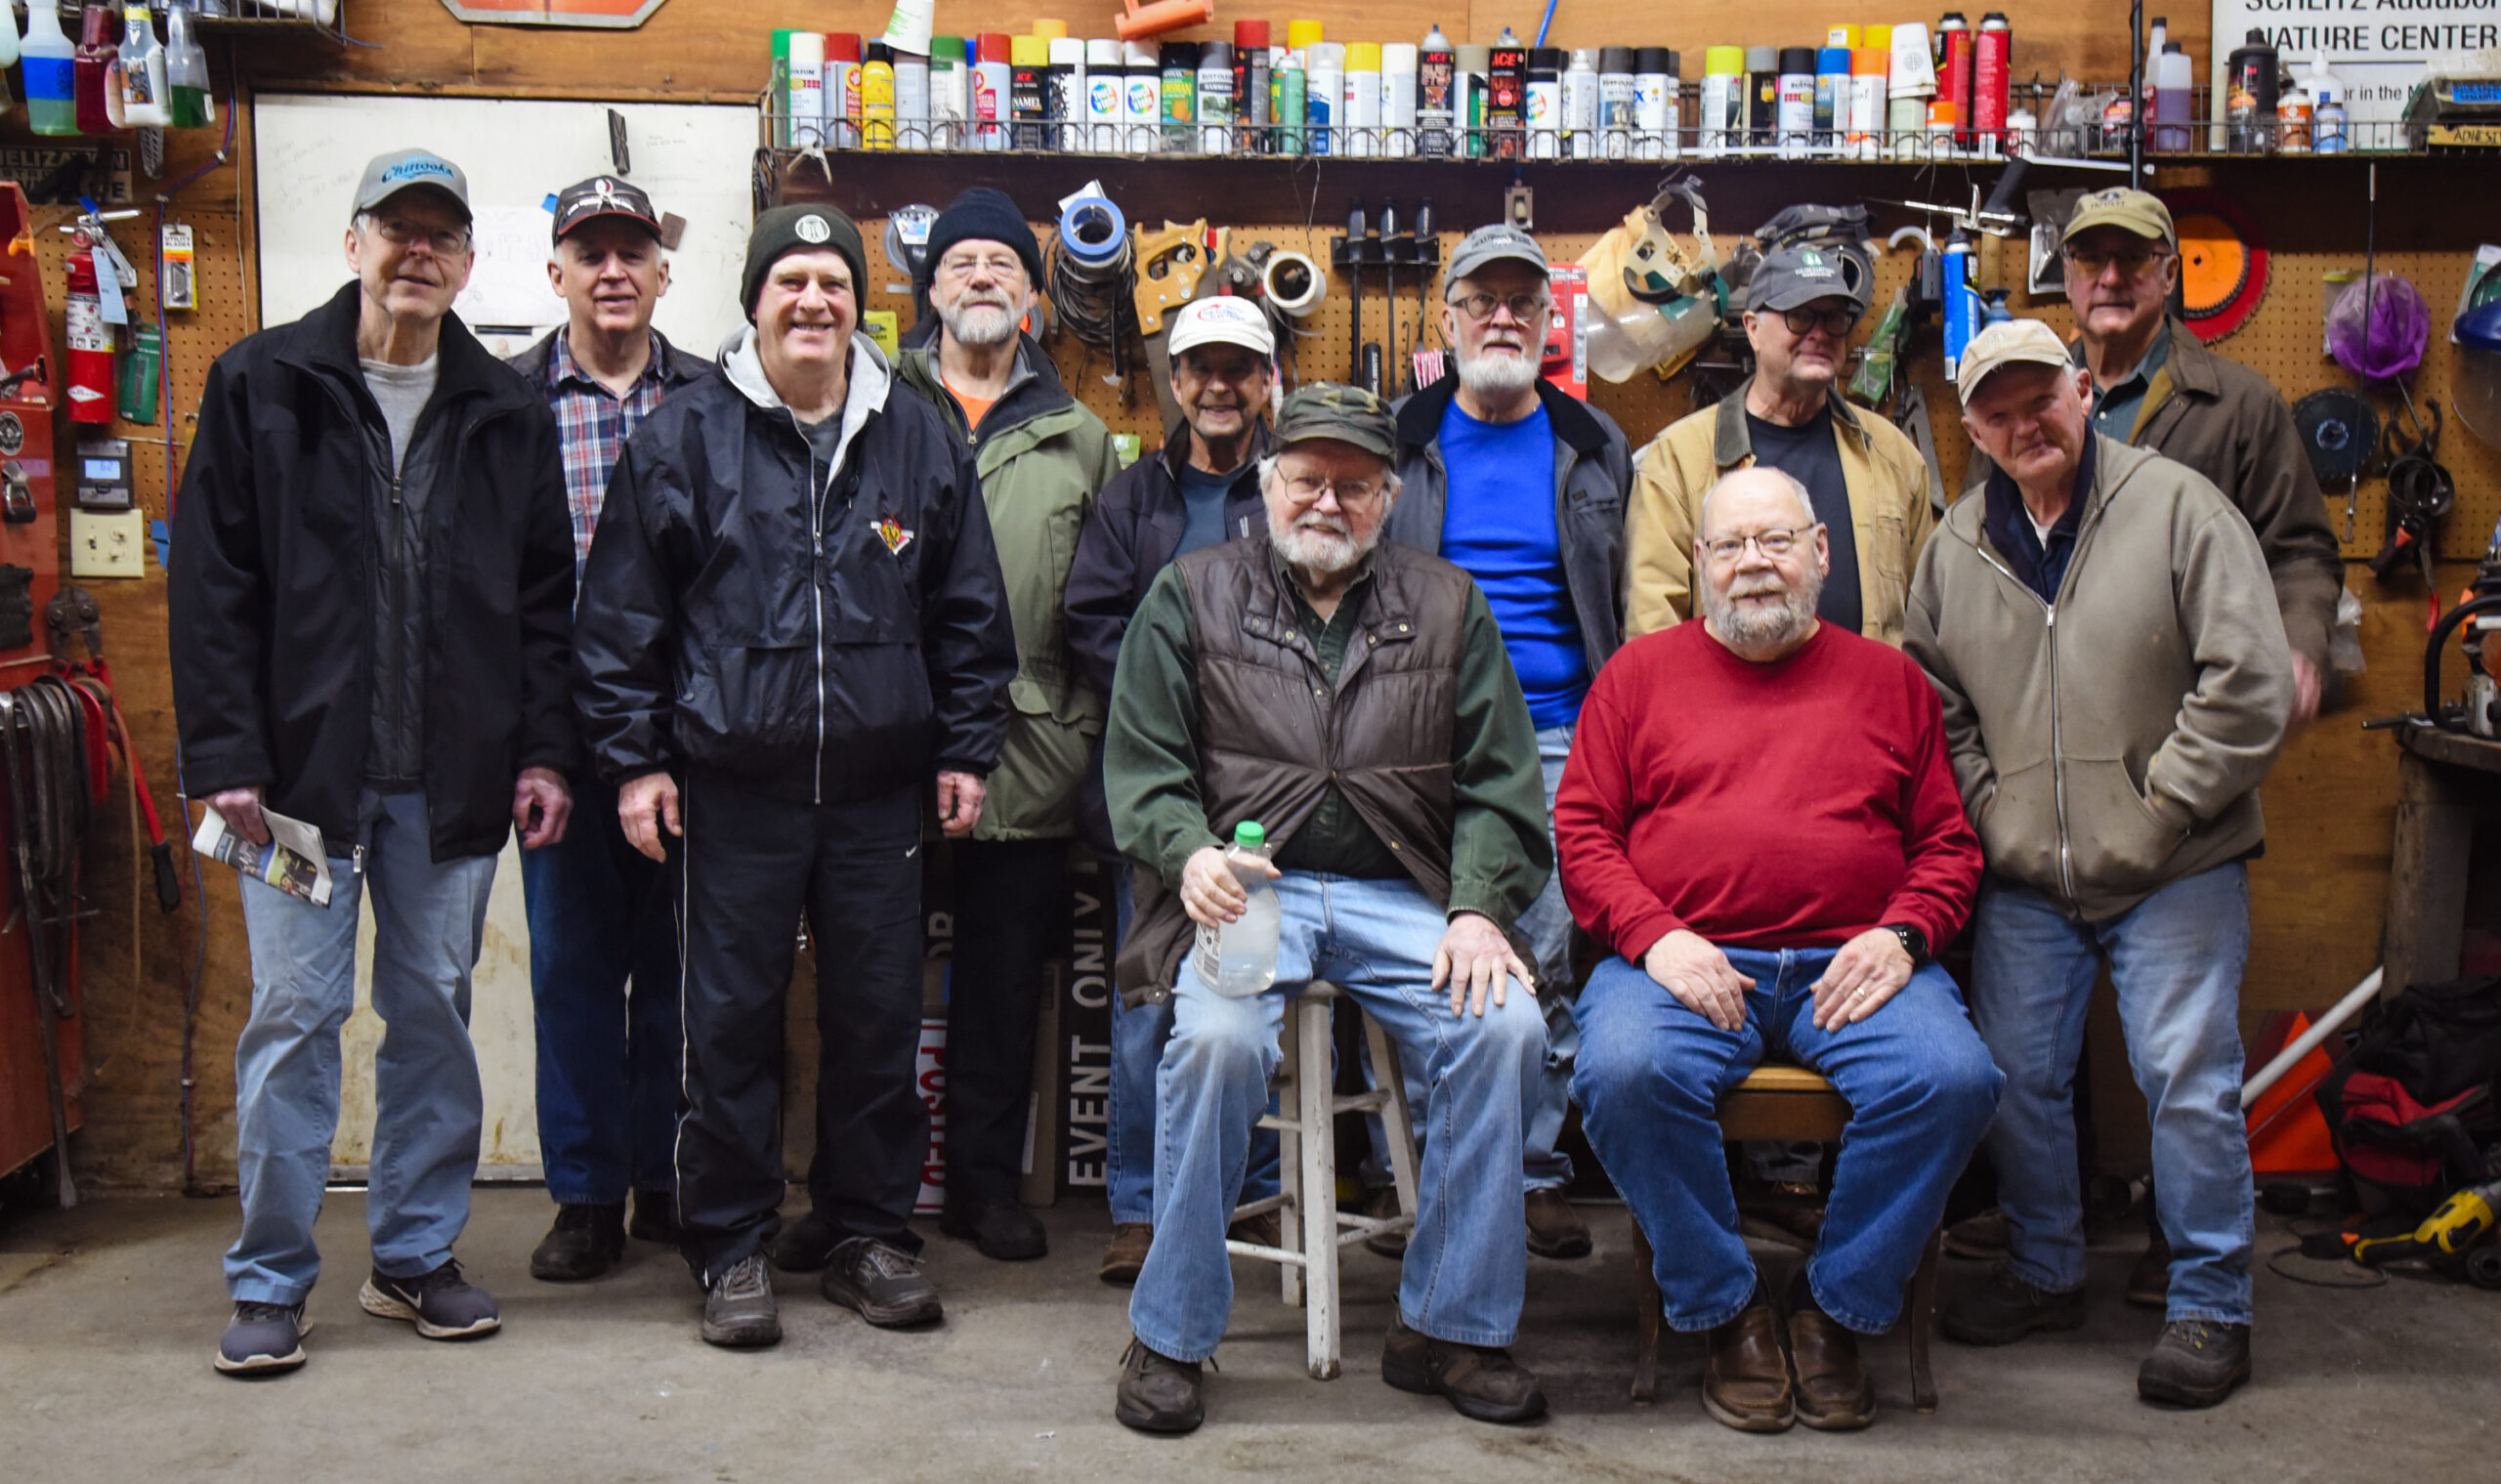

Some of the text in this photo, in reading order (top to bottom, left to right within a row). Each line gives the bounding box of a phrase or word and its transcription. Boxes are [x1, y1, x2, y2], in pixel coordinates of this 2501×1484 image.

[2381, 24, 2498, 51] CENTER
[1426, 52, 1449, 64] ACE
[1493, 52, 1516, 66] ACE
[2360, 85, 2374, 102] in
[2379, 85, 2402, 102] the
[1068, 1035, 1111, 1187] EVENT
